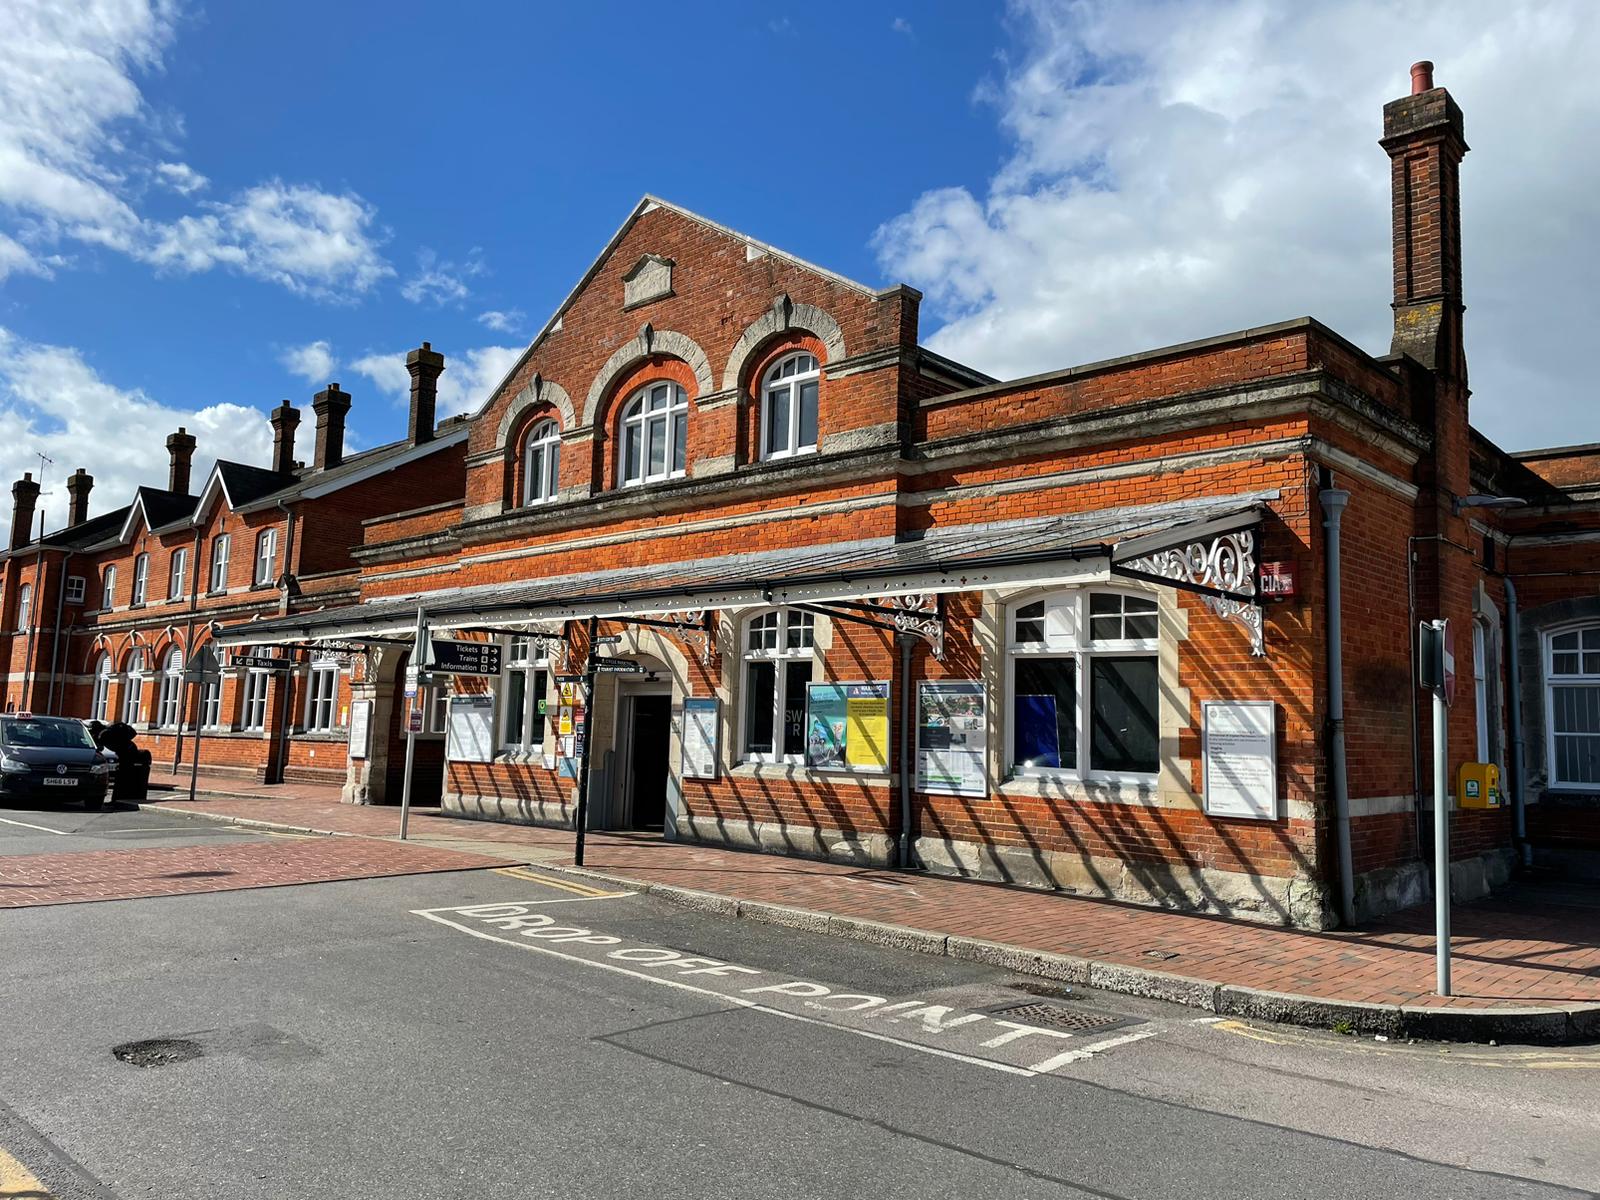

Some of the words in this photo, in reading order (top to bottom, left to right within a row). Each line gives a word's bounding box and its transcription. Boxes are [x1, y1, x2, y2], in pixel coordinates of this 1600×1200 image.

[456, 644, 478, 653] Tickets
[459, 654, 478, 663] Trains
[441, 662, 477, 671] Information
[455, 905, 622, 945] DROP
[606, 948, 761, 976] OFF
[740, 982, 1073, 1048] POINT
